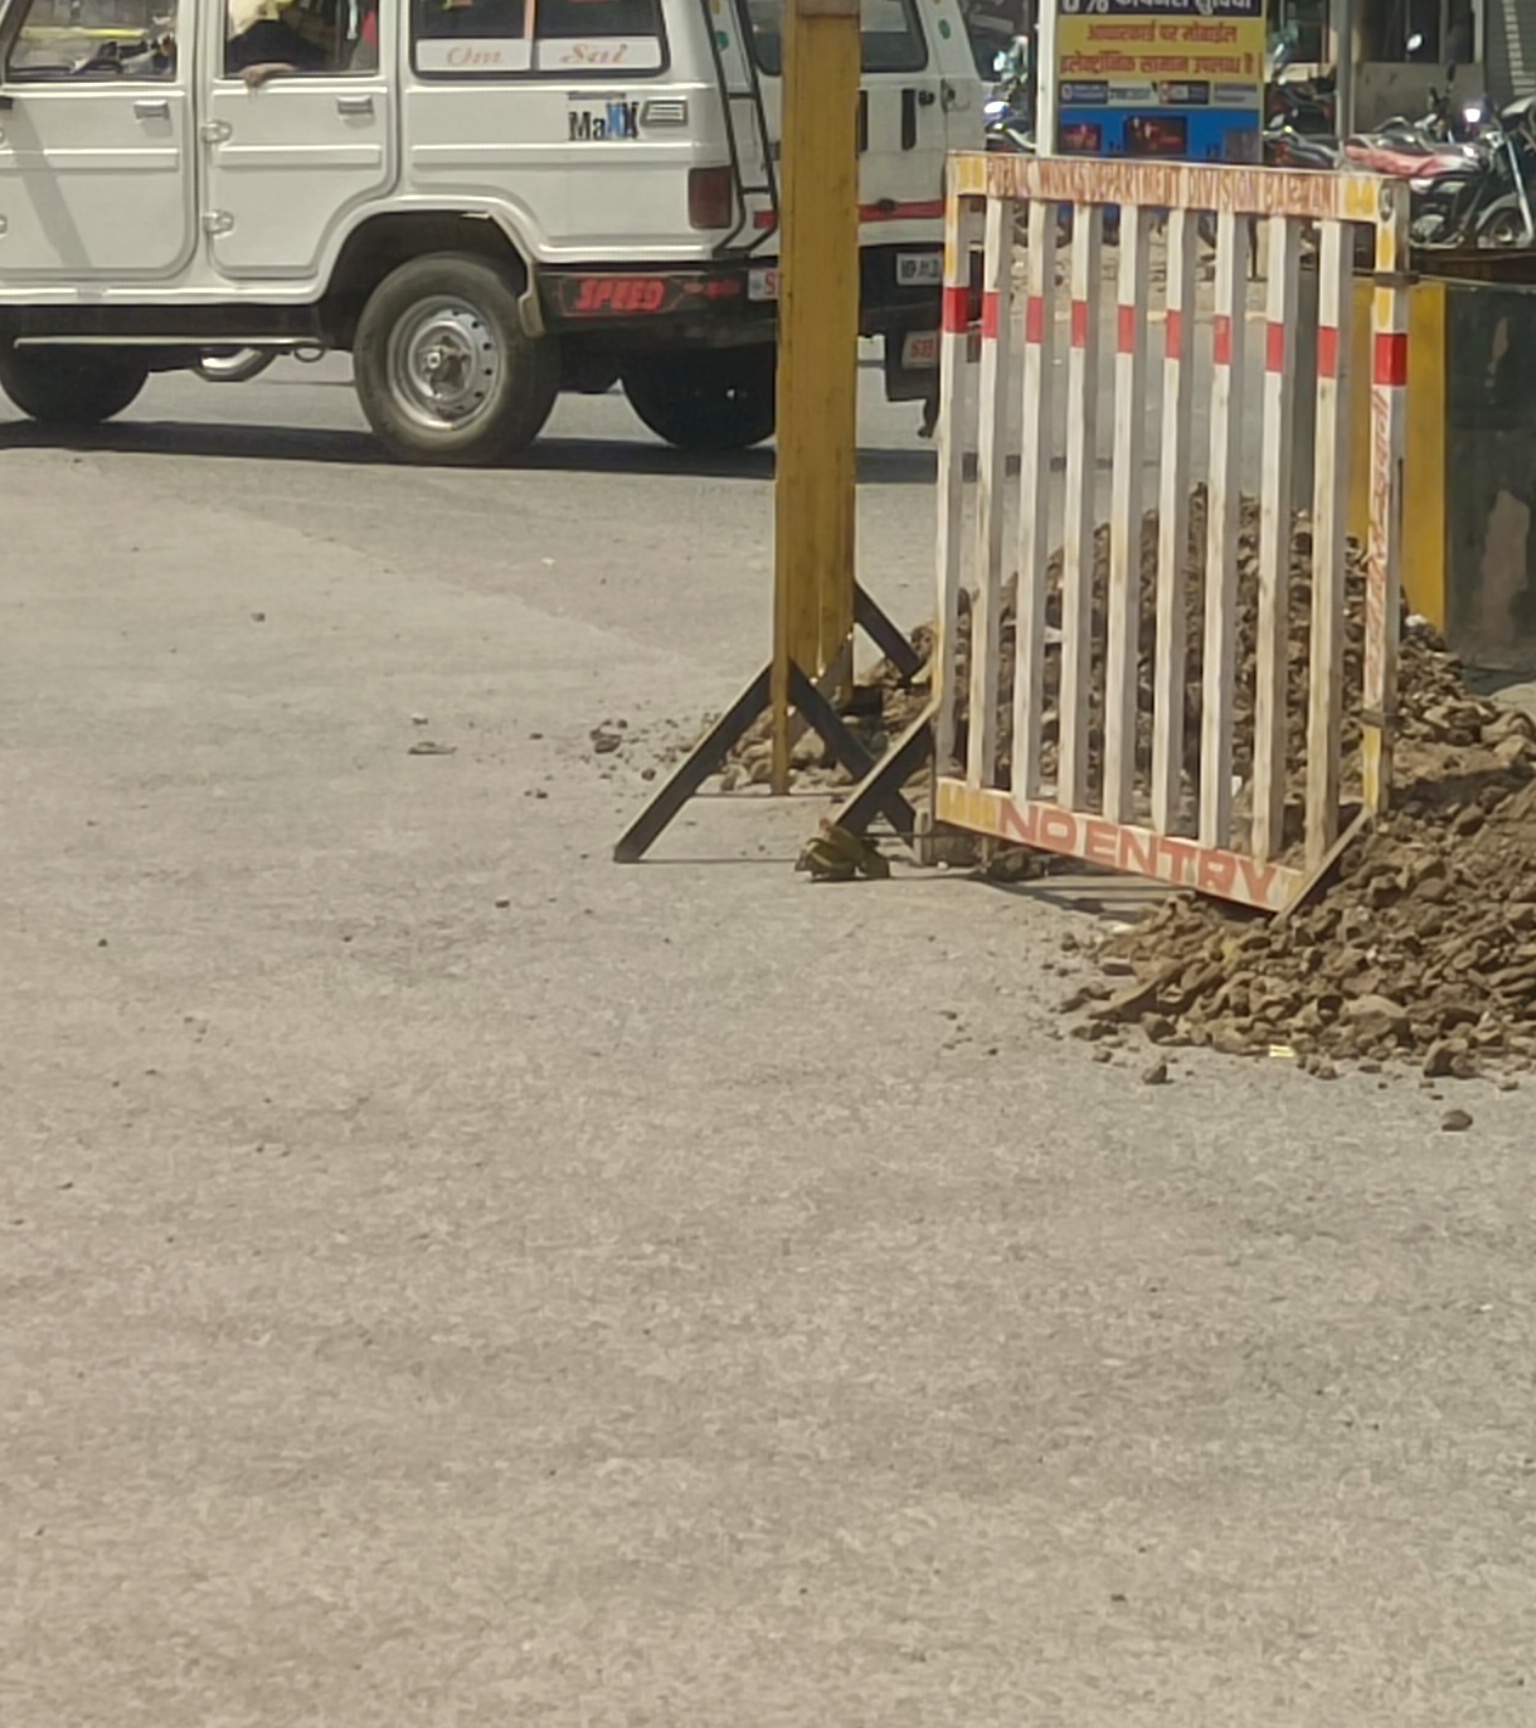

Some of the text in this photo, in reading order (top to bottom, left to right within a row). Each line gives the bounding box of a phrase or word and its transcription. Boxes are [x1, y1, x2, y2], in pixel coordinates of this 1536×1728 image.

[1187, 167, 1259, 214] DIVISION
[575, 277, 666, 312] SPEED
[999, 797, 1280, 905] NO ENTRY
